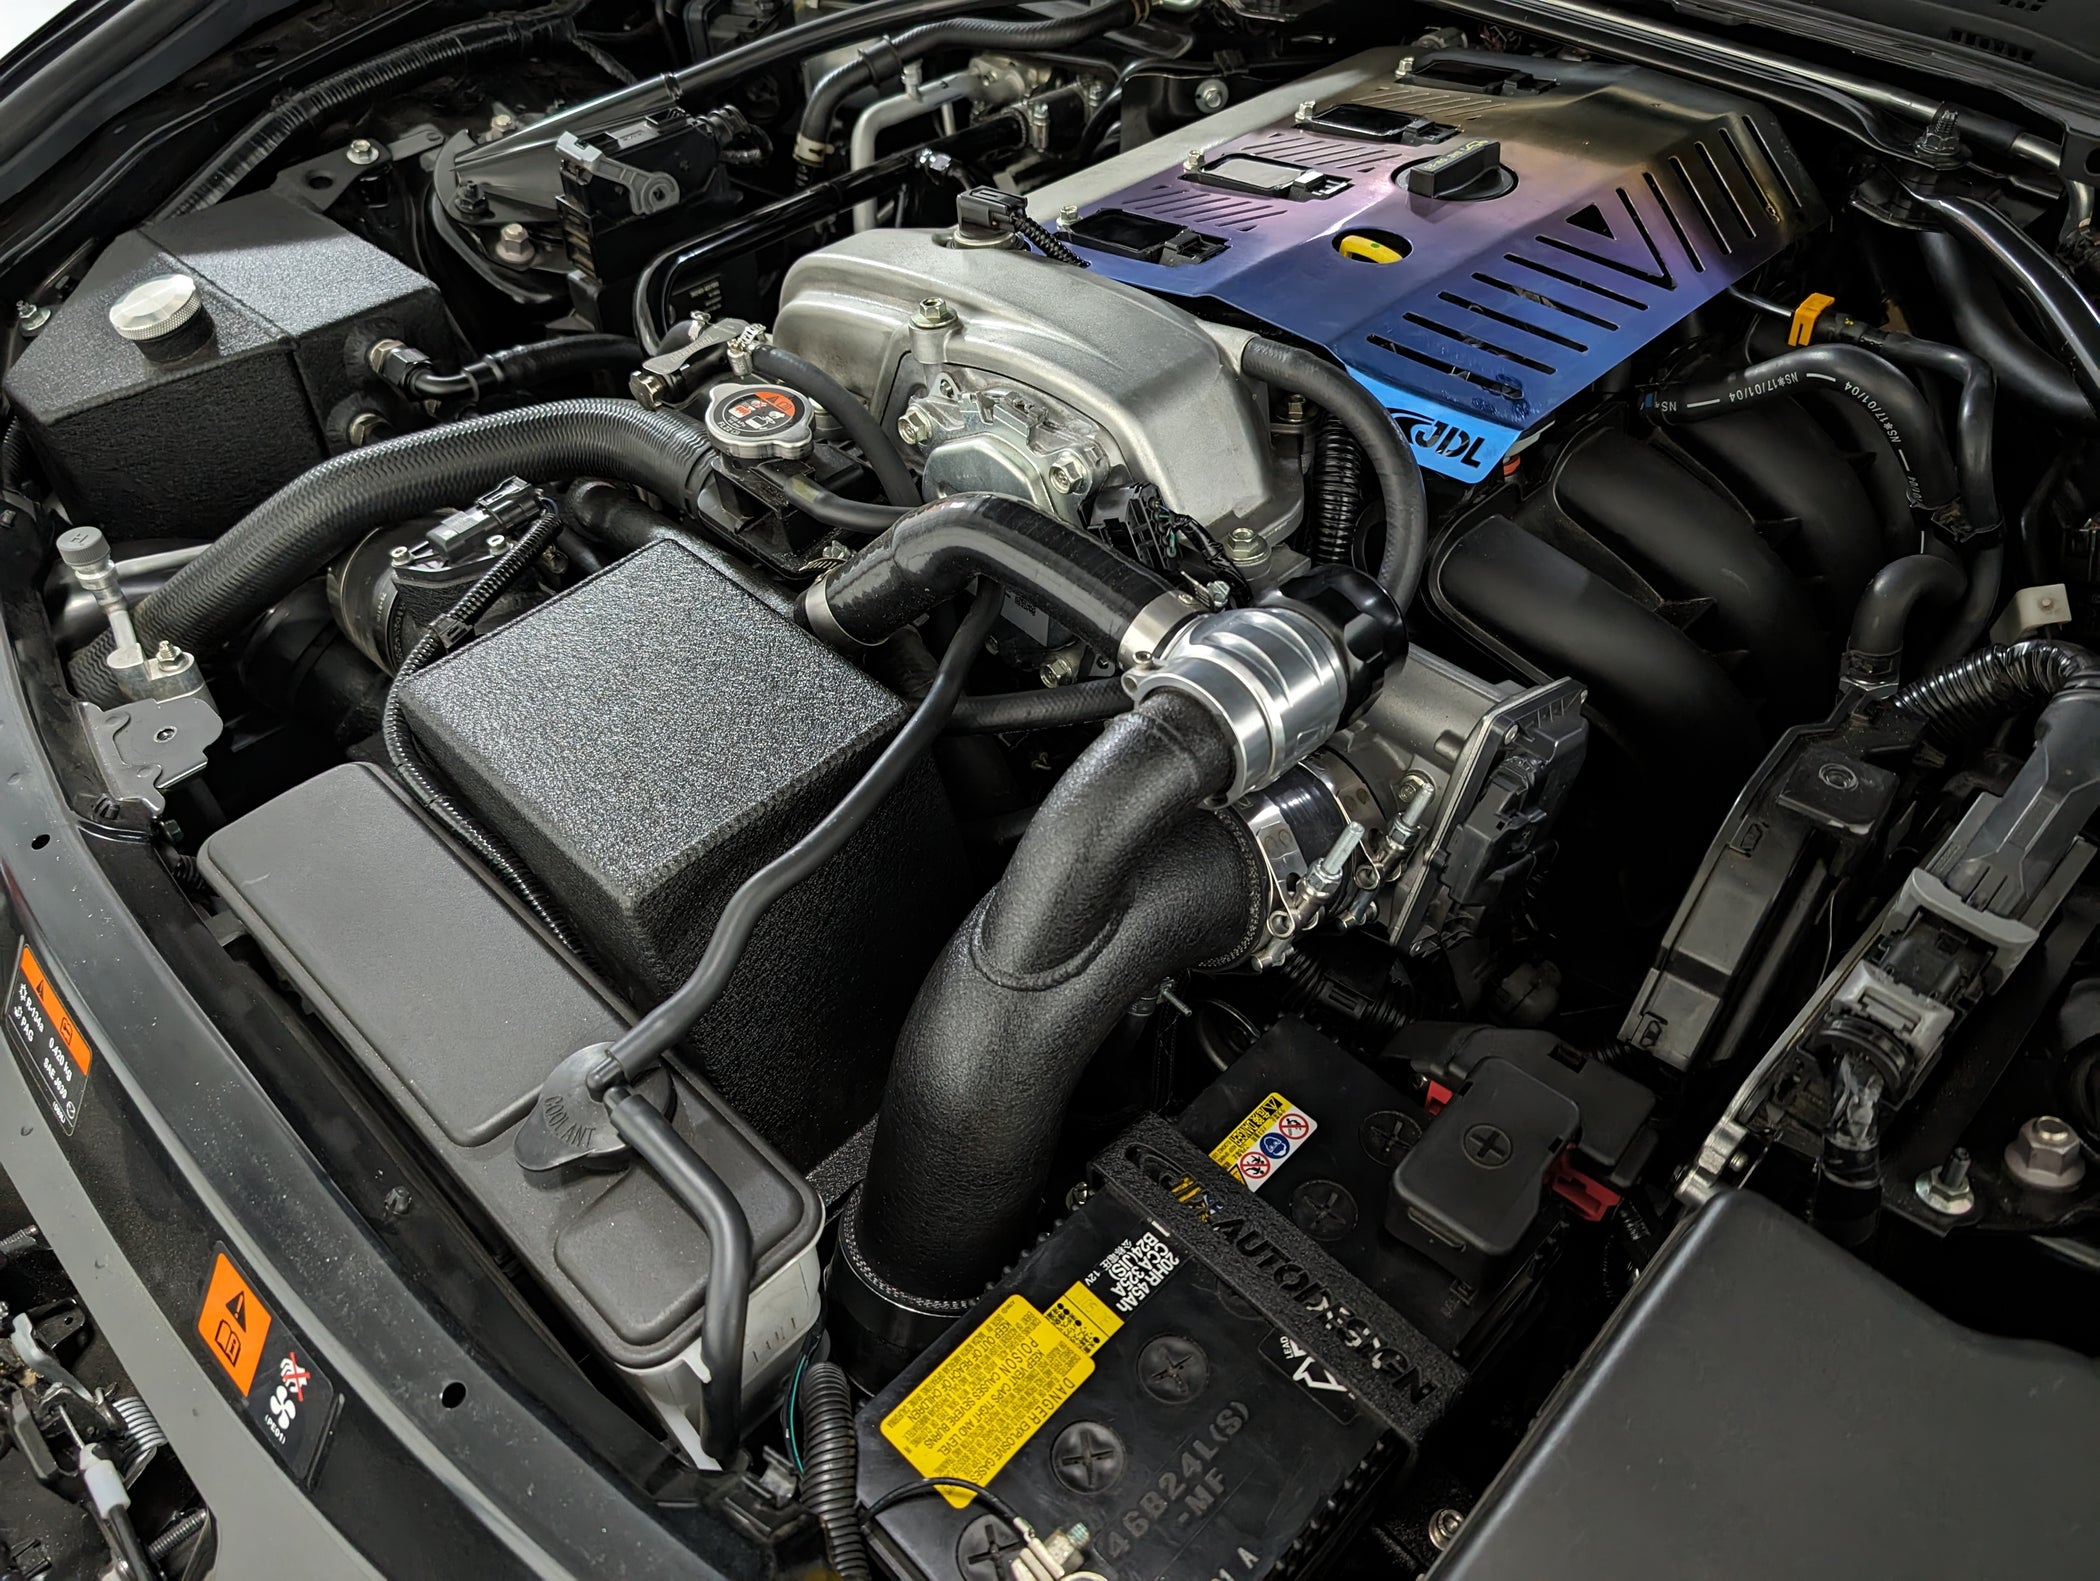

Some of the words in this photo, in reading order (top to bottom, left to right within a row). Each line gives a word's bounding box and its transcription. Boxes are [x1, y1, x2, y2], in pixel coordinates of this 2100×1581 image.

[1415, 420, 1485, 469] JDL
[20, 1016, 34, 1042] PAG
[43, 1057, 55, 1080] SAE
[26, 997, 44, 1033] R-134a
[63, 1059, 73, 1082] kg
[544, 1097, 595, 1147] COOLANT
[1229, 1117, 1258, 1147] DANGER
[1249, 1106, 1270, 1127] 危険
[1099, 1236, 1133, 1272] 公称電圧
[1106, 1228, 1159, 1284] B24(JIS)
[1137, 1239, 1170, 1273] CCA
[1143, 1249, 1181, 1288] 20HR
[1083, 1268, 1100, 1286] 12V
[1109, 1262, 1145, 1300] 325A
[1115, 1277, 1152, 1316] 45Ah
[1210, 1216, 1437, 1406] AUTODESIGN
[978, 1334, 996, 1352] OUT
[991, 1319, 1012, 1340] KEEP
[968, 1347, 983, 1362] OF
[998, 1334, 1039, 1377] POISON
[1023, 1348, 1044, 1370] KEEP
[1279, 1335, 1293, 1359] LEAD
[938, 1377, 952, 1392] OF
[947, 1356, 973, 1383] REACH
[1007, 1364, 1028, 1386] VENT
[971, 1370, 1001, 1401] CAUSES
[990, 1381, 1012, 1404] CAPS
[1026, 1375, 1076, 1426] DANGER
[906, 1386, 942, 1424] CHILDREN
[945, 1395, 976, 1427] SEVERE
[971, 1399, 994, 1423] TIGHT
[264, 1414, 285, 1444] (PE01)
[922, 1421, 951, 1450] BURNS
[956, 1418, 976, 1437] AND
[990, 1419, 1031, 1461] EXPLOSIVE
[936, 1432, 962, 1458] LEVEL
[968, 1455, 996, 1484] GASES
[1105, 1400, 1250, 1559] 46B24L(S)
[1175, 1468, 1227, 1527] -MF
